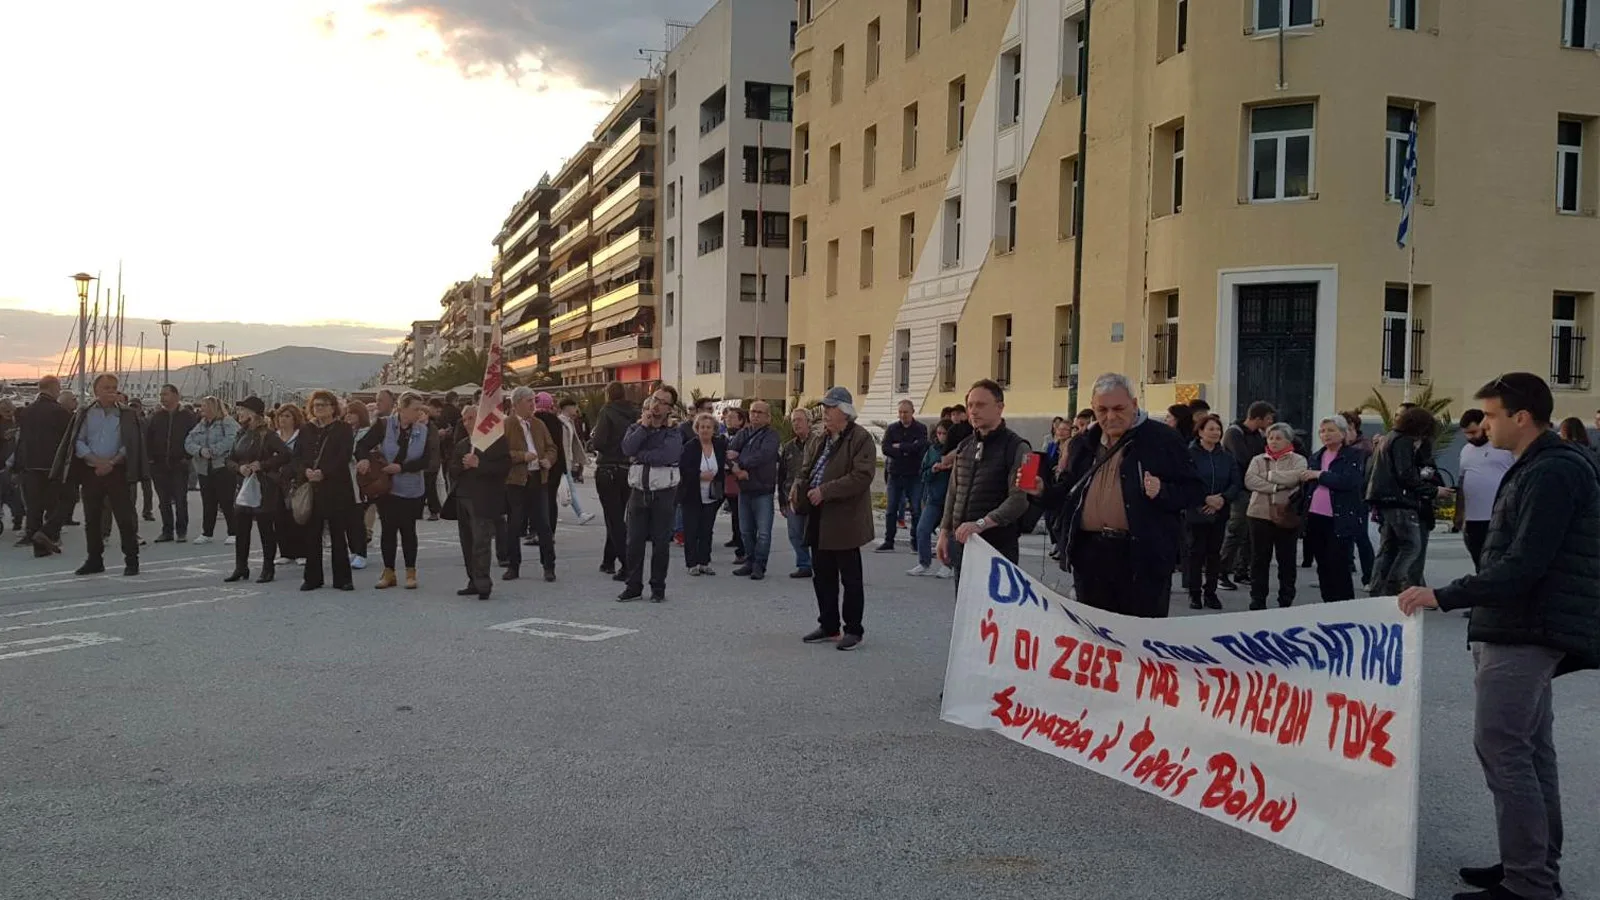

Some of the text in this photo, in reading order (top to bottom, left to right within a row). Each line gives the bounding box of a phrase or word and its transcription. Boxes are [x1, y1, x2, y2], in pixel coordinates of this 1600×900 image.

[1014, 629, 1039, 671] ΟΙ
[1050, 635, 1123, 692] ΖΩΕΣ
[1136, 657, 1180, 708] ΜΑΣ
[1240, 670, 1312, 746] ΚΕΡΔΗ
[1326, 692, 1396, 767] ΤΟΥΣ
[1201, 752, 1297, 832] Βόλου
